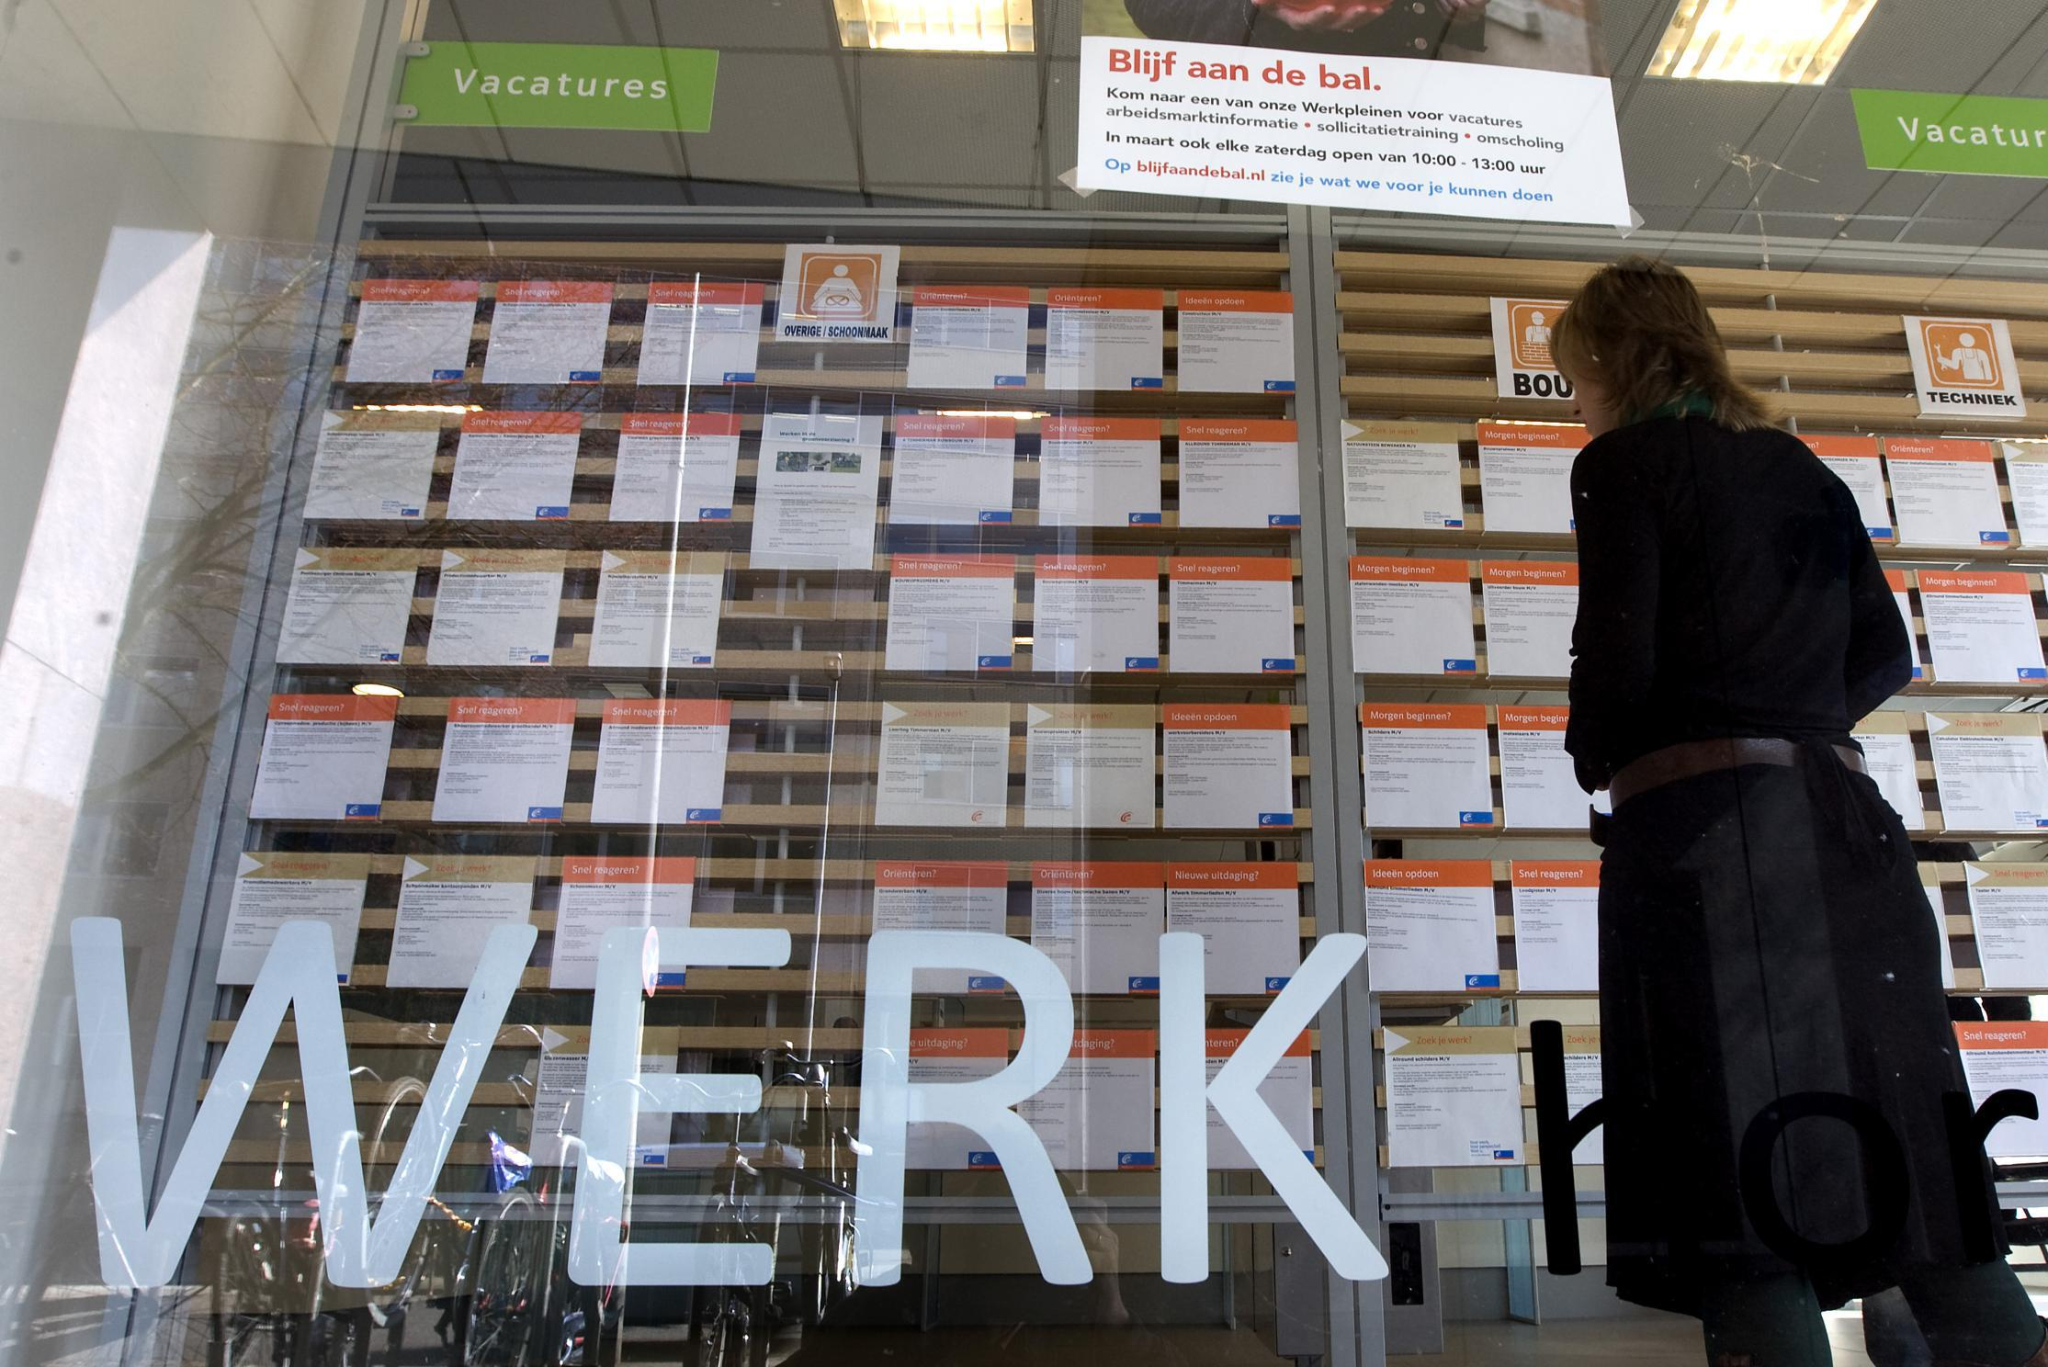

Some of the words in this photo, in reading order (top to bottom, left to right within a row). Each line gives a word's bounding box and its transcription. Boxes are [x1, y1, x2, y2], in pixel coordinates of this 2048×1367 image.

[1109, 48, 1177, 82] Blijf
[1187, 61, 1249, 82] aan
[1262, 60, 1306, 87] de
[1319, 63, 1381, 91] bal.
[454, 68, 667, 99] Vacatures
[1107, 87, 1145, 100] Kom
[1150, 92, 1185, 104] naar
[1191, 95, 1220, 106] een
[1225, 97, 1253, 109] van
[1259, 100, 1297, 112] onze
[1302, 101, 1402, 118] Werkpleinen
[1407, 110, 1444, 121] voor
[1448, 113, 1523, 129] vacatures
[1106, 106, 1298, 130] arbeidsmarktinformatie
[1317, 121, 1459, 144] sollicitatietraining
[1477, 135, 1564, 153] omscholing
[1897, 116, 2048, 148] Vacatur
[1106, 131, 1120, 143] In
[1126, 135, 1174, 147] maart
[1179, 137, 1211, 149] ook
[1216, 139, 1249, 153] elke
[1255, 144, 1327, 161] zaterdag
[1332, 150, 1373, 163] open
[1378, 152, 1406, 163] van
[1412, 153, 1456, 167] 10:00
[1472, 158, 1515, 172] 13:00
[1520, 164, 1546, 175] uur
[1105, 158, 1131, 174] Op
[1137, 160, 1265, 181] blijfaandebal.nl
[1271, 171, 1294, 183] zie
[1299, 173, 1315, 188] je
[1319, 176, 1351, 188] wat
[1356, 178, 1381, 190] we
[1386, 181, 1424, 192] voor
[1428, 181, 1443, 197] je
[1448, 182, 1507, 199] kunnen
[1512, 188, 1553, 202] doen
[655, 289, 673, 297] Snel
[1185, 297, 1212, 306] Ideeën
[1215, 297, 1245, 308] opdoen
[784, 325, 822, 337] OVERIGE
[823, 325, 826, 337] /
[828, 326, 888, 338] SCHOONMAAK
[1513, 372, 1574, 398] BOU
[1926, 391, 2018, 406] TECHNIEK
[471, 418, 488, 427] Snel
[491, 418, 532, 429] reageren?
[650, 420, 691, 430] reagere?
[904, 421, 921, 431] Snel
[924, 421, 965, 434] reageren?
[1049, 423, 1066, 433] Snel
[1069, 423, 1110, 435] reageren?
[1186, 425, 1204, 435] Snel
[1207, 425, 1247, 437] reageren?
[1485, 430, 1516, 441] Morgen
[1518, 431, 1559, 442] beginnen?
[1890, 444, 1934, 455] Oriënteren?
[899, 561, 917, 571] Snel
[920, 562, 962, 573] reageren?
[1043, 562, 1061, 572] Snel
[1064, 563, 1107, 574] reageren?
[1177, 563, 1196, 573] Snel
[1199, 564, 1240, 575] reageren?
[1357, 564, 1390, 574] Morgen
[1392, 565, 1435, 576] beginnen?
[1489, 568, 1521, 579] Morgen
[1523, 568, 1566, 580] beginnen?
[1925, 577, 1956, 587] Morgen
[1957, 577, 1997, 588] beginnen?
[279, 703, 298, 713] Snel
[300, 703, 344, 715] reageren?
[457, 705, 477, 715] Snel
[479, 705, 522, 717] reageren?
[612, 706, 631, 716] Snel
[633, 706, 677, 718] reageren?
[1171, 712, 1200, 721] Ideeën
[1203, 712, 1237, 724] opdoen
[1370, 711, 1404, 722] Morgen
[1406, 711, 1451, 723] beginnen?
[1505, 713, 1538, 724] Morgen
[1540, 714, 1569, 724] beginn
[572, 865, 591, 875] Snel
[594, 865, 639, 878] reageren?
[883, 868, 937, 879] Oriënteren?
[1040, 869, 1094, 880] Oriënteren?
[1175, 871, 1209, 880] Nieuwe
[1211, 871, 1259, 884] uitdaging?
[1372, 869, 1403, 878] Ideeën
[1405, 869, 1439, 880] opdoen
[1519, 869, 1538, 879] Snel
[1540, 869, 1583, 880] reageren?
[1416, 1035, 1437, 1045] Zoek
[1438, 1035, 1447, 1048] je
[1448, 1035, 1472, 1045] werk?
[1567, 1035, 1586, 1044] Zoek
[1588, 1035, 1596, 1047] je
[1963, 1031, 1983, 1040] Snel
[1985, 1031, 2027, 1041] reageren?
[918, 1037, 968, 1051] uitdaging?
[1073, 1038, 1115, 1051] tdaging?
[1205, 1038, 1239, 1048] nteren?
[69, 916, 1390, 1291] WERK
[1530, 1019, 2039, 1276] hor
